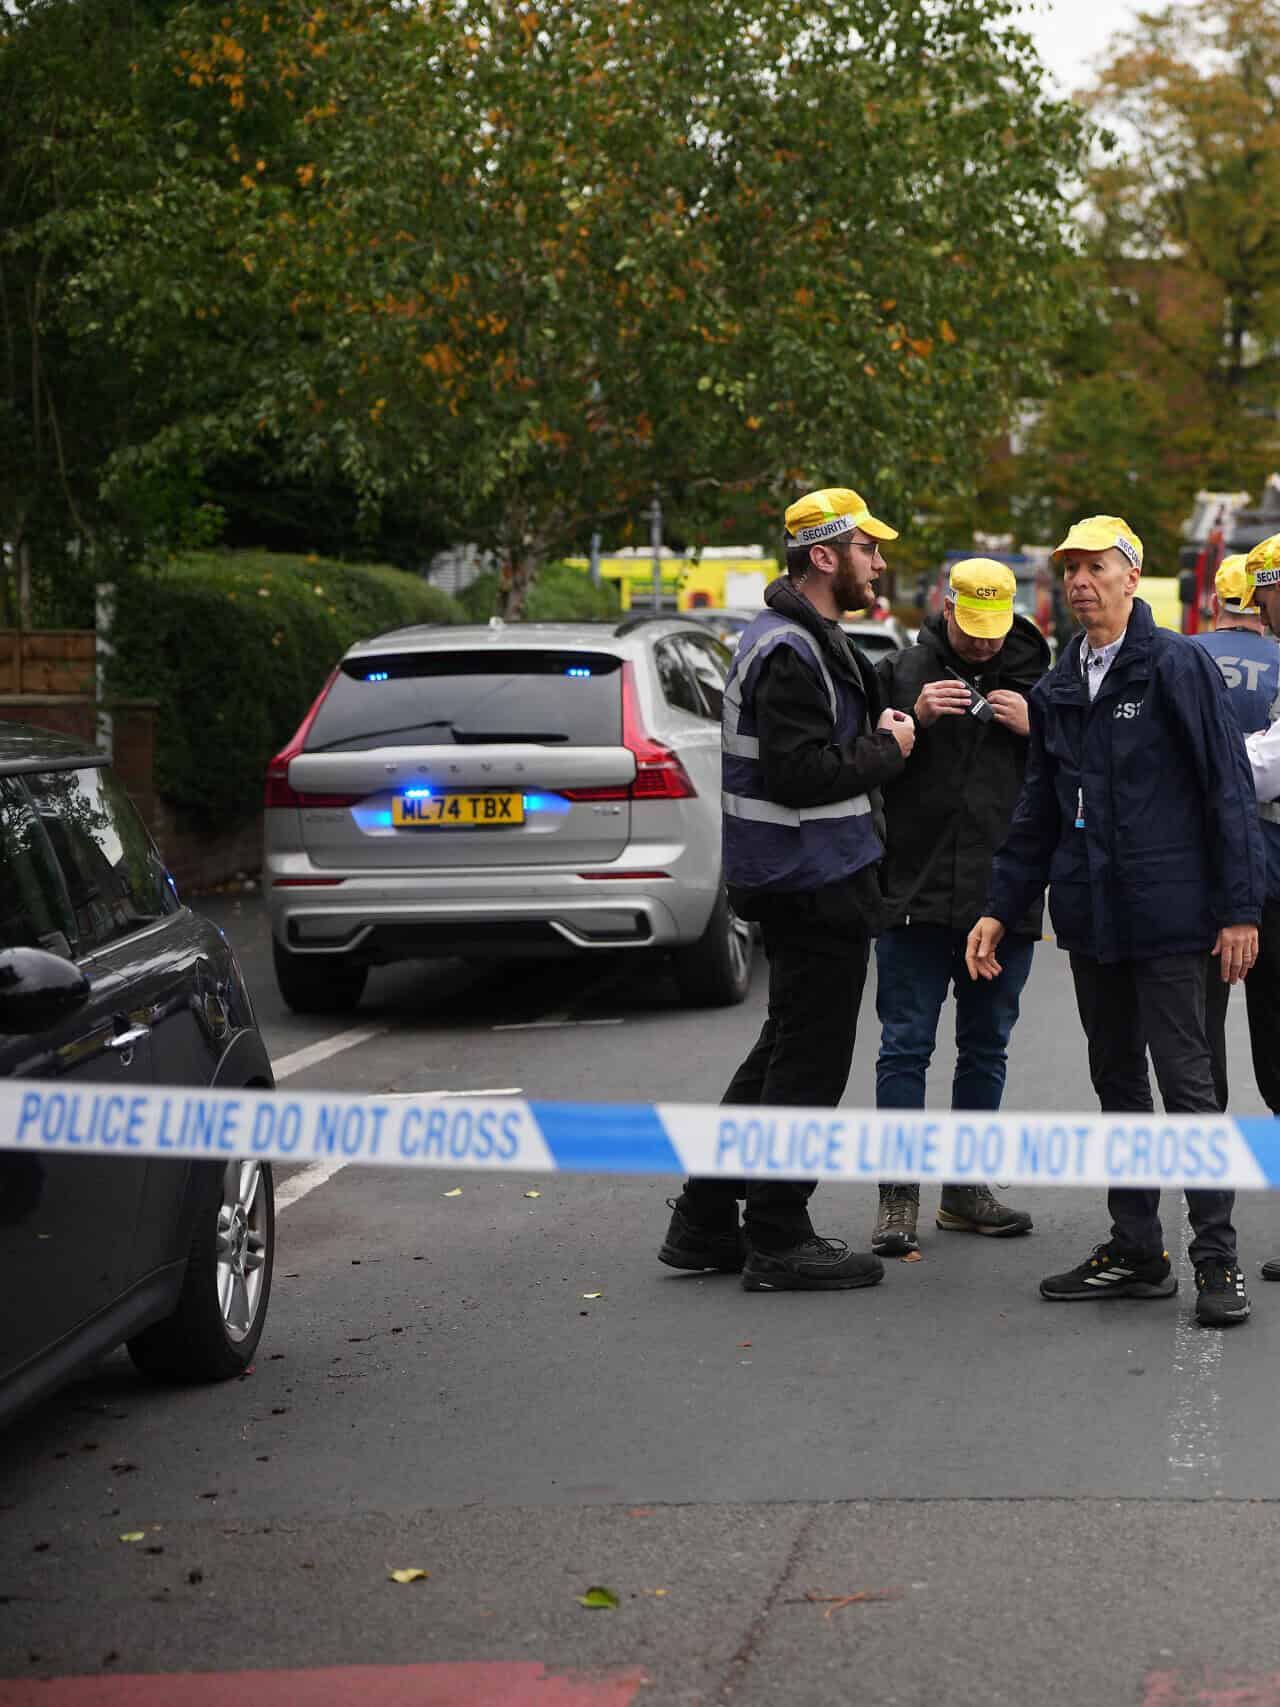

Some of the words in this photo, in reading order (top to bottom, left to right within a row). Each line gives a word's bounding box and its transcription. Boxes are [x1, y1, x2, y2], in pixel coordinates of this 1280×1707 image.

[803, 518, 848, 540] SECURITY
[976, 588, 998, 597] CST
[1213, 656, 1270, 690] ST
[469, 796, 512, 819] TBX
[17, 1091, 142, 1147] POLICE
[157, 1097, 239, 1152] LINE
[251, 1103, 301, 1154] DO
[315, 1104, 388, 1156] NOT
[400, 1107, 521, 1160] CROSS
[716, 1118, 842, 1170] POLICE
[856, 1121, 939, 1173] LINE
[953, 1124, 1005, 1175] DO
[1018, 1126, 1092, 1177] NOT
[1104, 1126, 1230, 1178] CROSS
